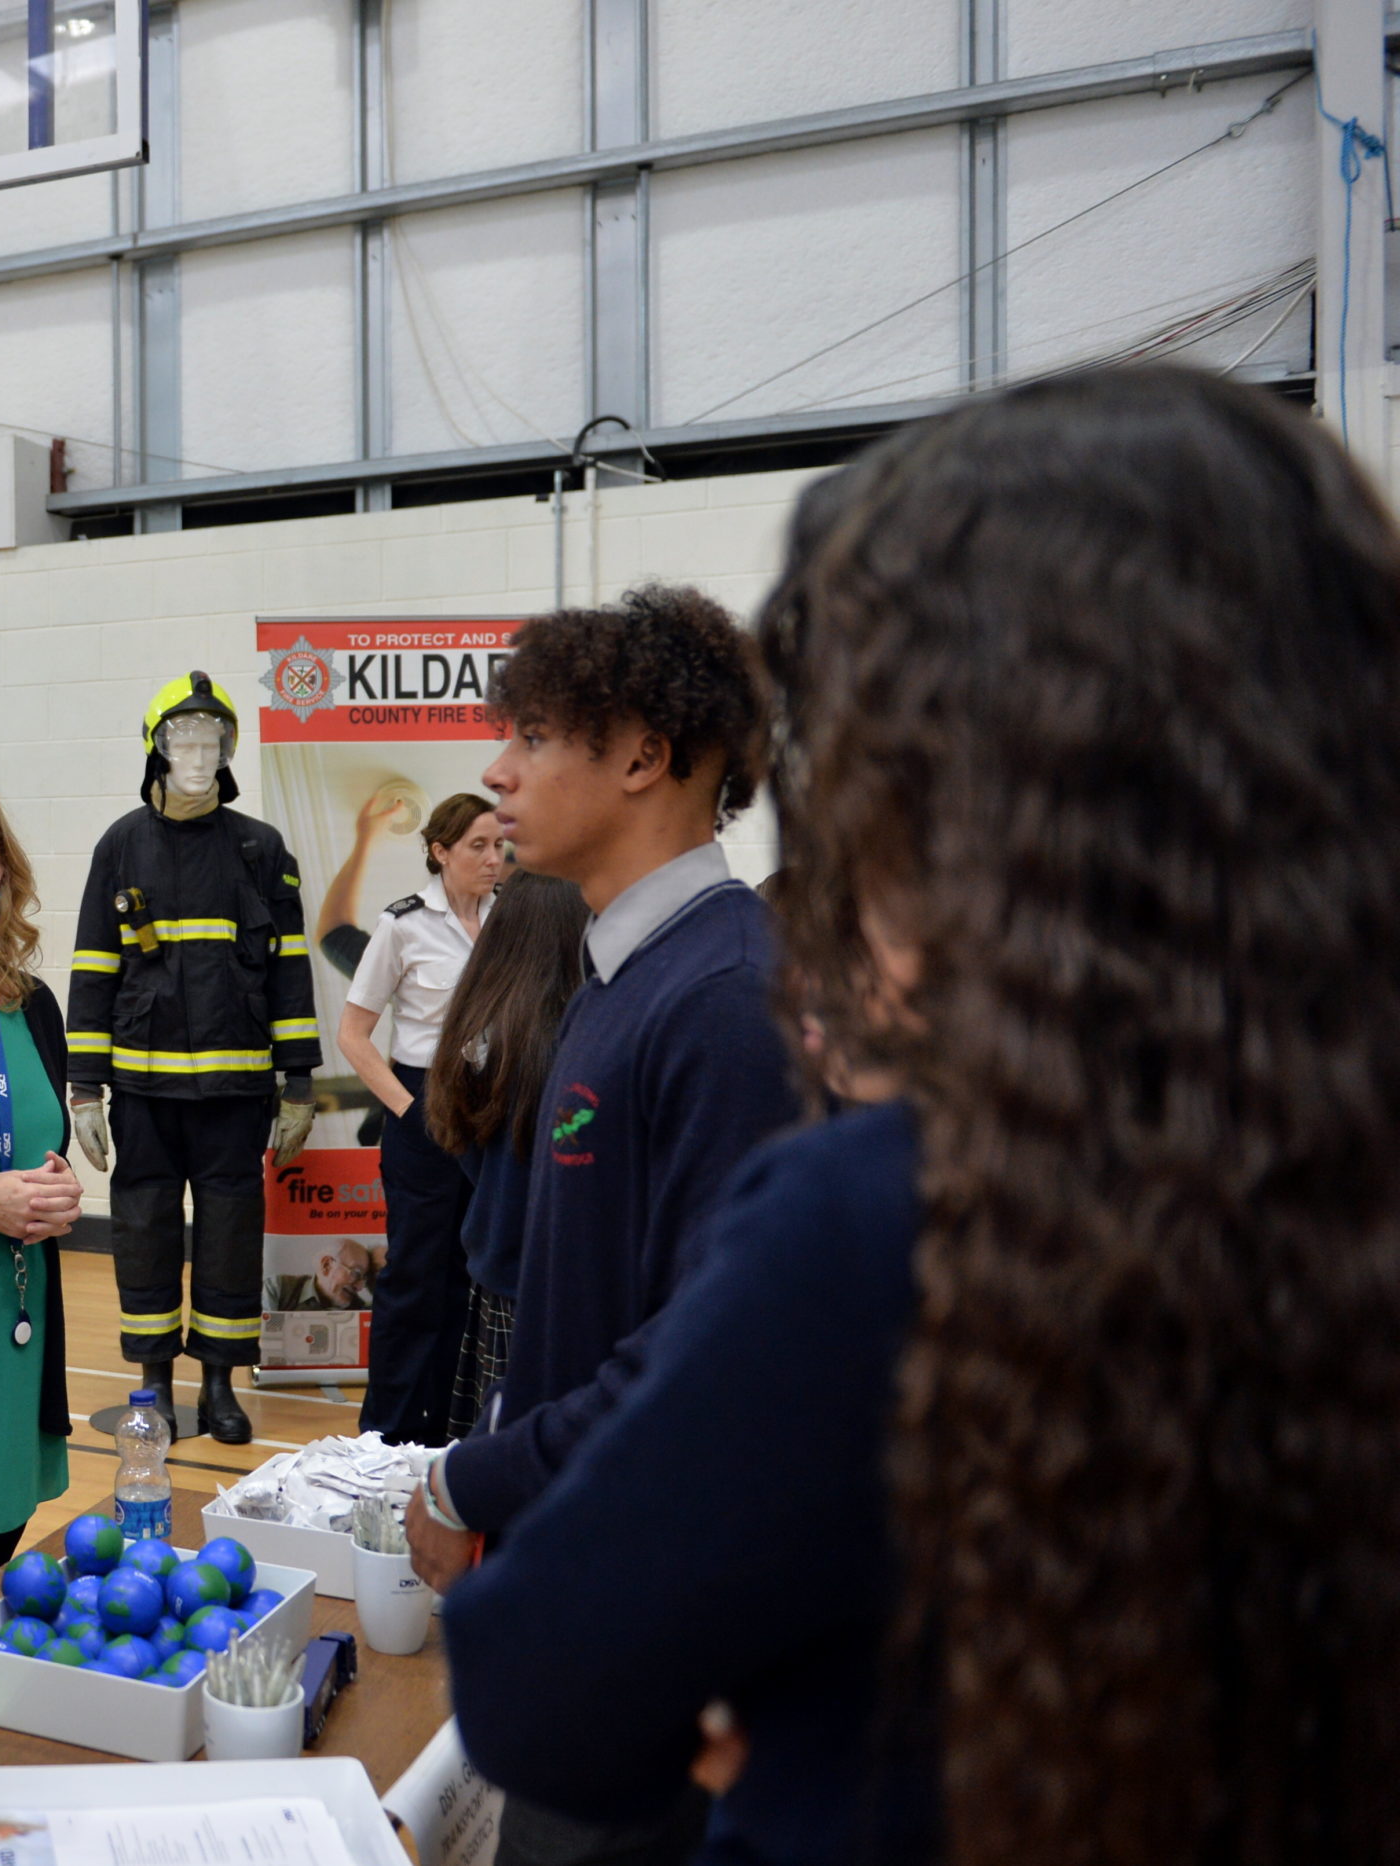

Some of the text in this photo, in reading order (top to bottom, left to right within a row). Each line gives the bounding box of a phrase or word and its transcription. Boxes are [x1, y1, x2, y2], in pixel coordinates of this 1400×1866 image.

[348, 634, 371, 646] TO
[376, 633, 455, 646] PROTECT
[460, 633, 496, 645] AND
[295, 689, 325, 706] SERVICE
[349, 707, 421, 724] COUNTY
[427, 707, 466, 723] FIRE
[2, 1132, 11, 1158] DSV
[288, 1178, 334, 1203] fire
[309, 1209, 324, 1219] Be
[326, 1210, 340, 1218] on
[344, 1210, 368, 1220] your
[399, 1578, 422, 1588] DSV
[439, 1779, 457, 1817] DSV
